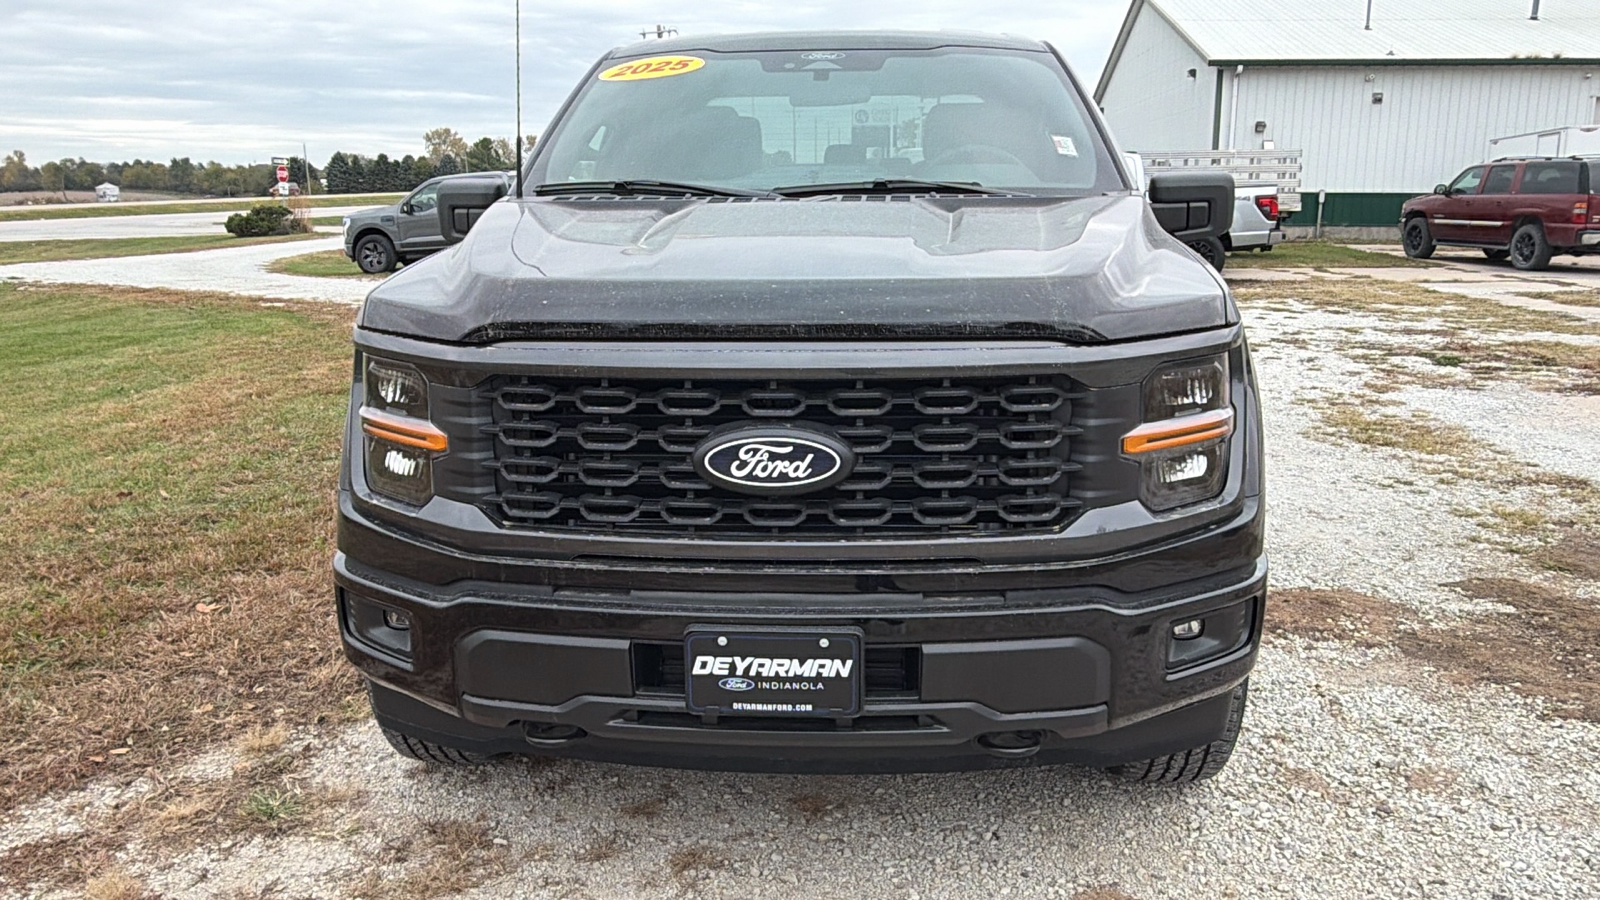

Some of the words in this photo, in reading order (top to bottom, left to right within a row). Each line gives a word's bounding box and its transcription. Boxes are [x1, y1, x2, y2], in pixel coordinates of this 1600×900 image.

[608, 59, 694, 78] 2025
[730, 443, 814, 478] Ford
[692, 655, 853, 678] DEYARMAN
[758, 681, 824, 690] INDIANOLA
[732, 702, 813, 711] DEYARMANFORD.COM
